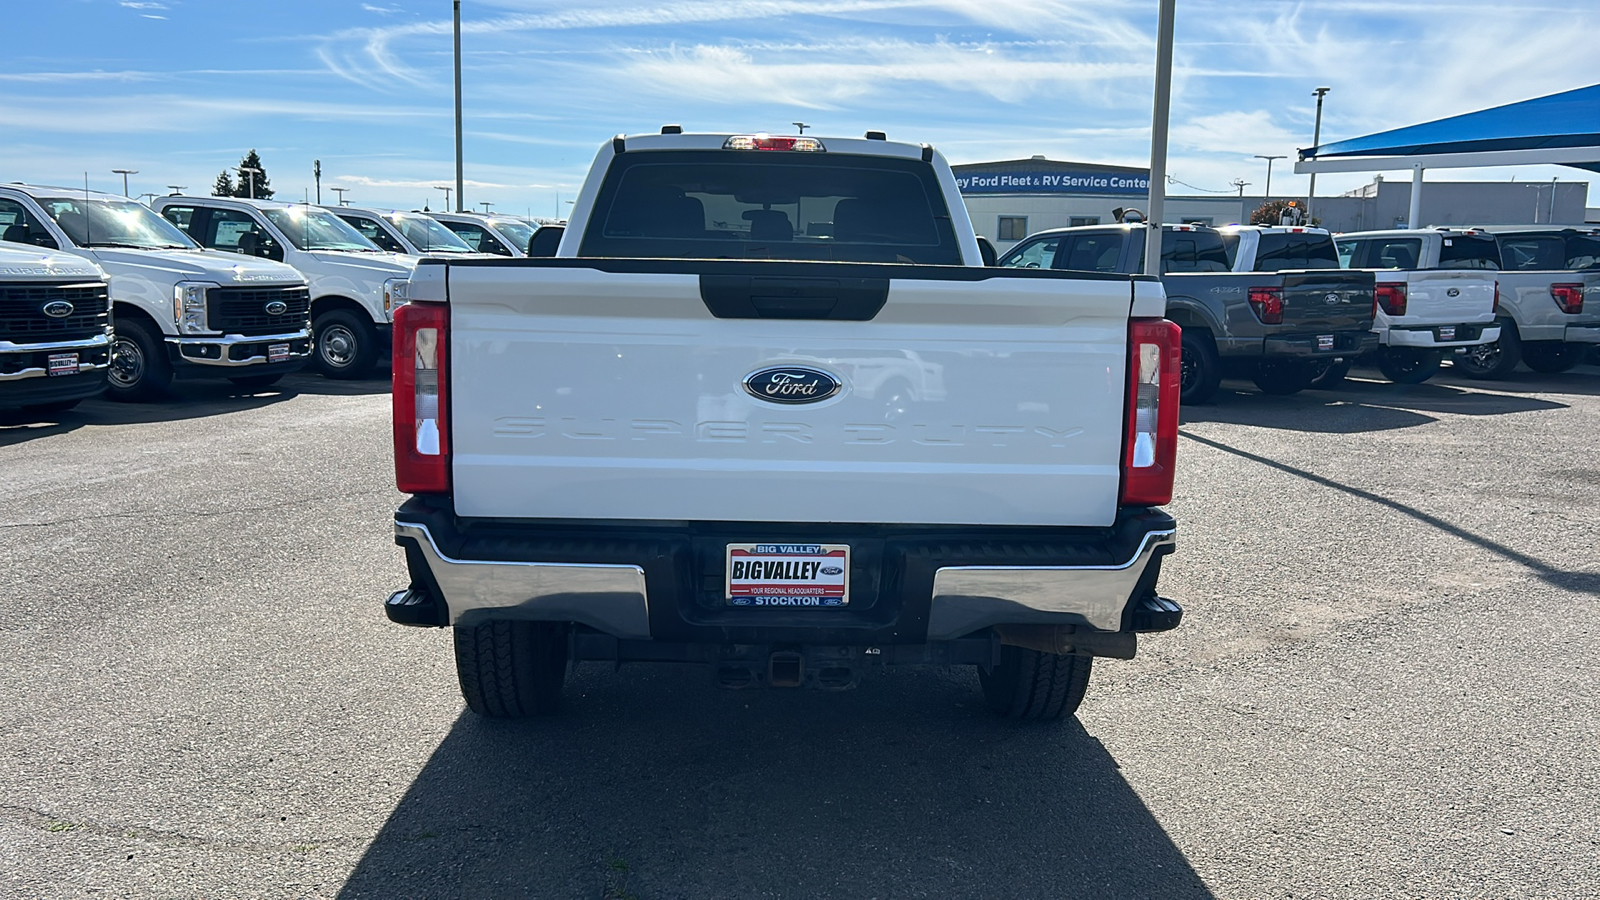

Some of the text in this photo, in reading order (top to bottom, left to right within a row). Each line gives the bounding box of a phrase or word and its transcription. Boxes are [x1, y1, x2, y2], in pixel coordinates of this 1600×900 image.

[971, 176, 998, 186] Ford
[1001, 175, 1031, 186] Fleet
[1033, 177, 1040, 186] &
[1042, 175, 1060, 186] RV
[1062, 176, 1108, 187] Service
[765, 372, 818, 395] Ford
[493, 416, 1085, 448] SUPER DUTY
[780, 546, 820, 554] VALLEY
[732, 560, 821, 580] BIGVALLEY
[750, 587, 825, 595] YOUR REGIONAL HEADQUARTERS
[755, 596, 820, 606] STOCKTON
